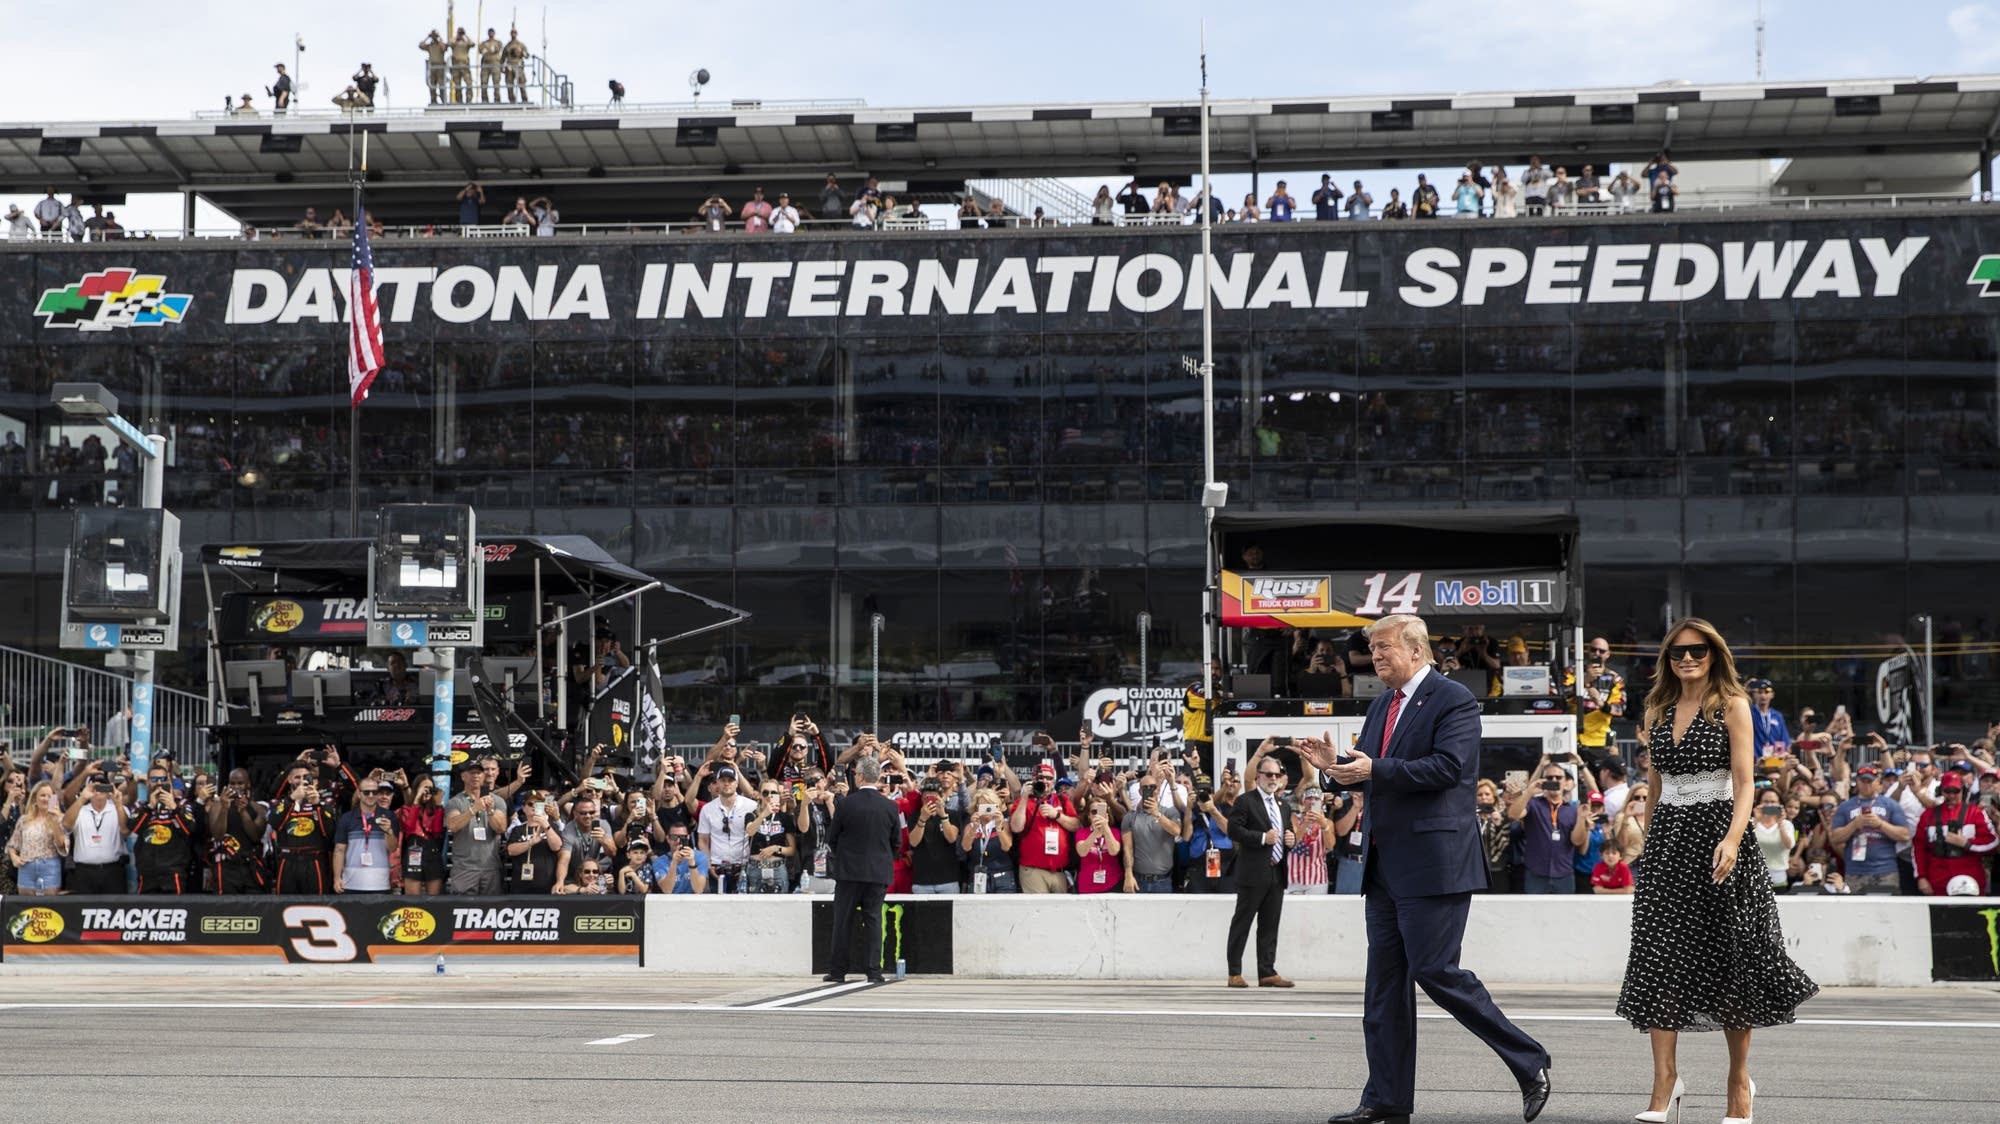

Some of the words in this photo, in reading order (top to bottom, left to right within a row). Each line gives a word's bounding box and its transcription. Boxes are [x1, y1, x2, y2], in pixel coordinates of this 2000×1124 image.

[225, 264, 610, 324] DAYTONA
[636, 250, 1369, 320] INTERNATIONAL
[1399, 236, 1930, 308] SPEEDWAY
[218, 558, 262, 567] CHEVROLET
[1355, 572, 1422, 615] 14
[1435, 579, 1518, 606] Mobil
[1258, 599, 1282, 608] TRUCK
[1283, 599, 1314, 608] CENTERS
[1130, 716, 1173, 733] LANE
[31, 909, 52, 920] Bass
[81, 908, 188, 930] TRACKER
[402, 909, 424, 920] Bass
[453, 907, 560, 929] TRACKER
[31, 918, 47, 929] Pro
[402, 918, 419, 929] Pro
[31, 926, 57, 938] Shops
[122, 930, 146, 942] OFF
[149, 930, 186, 942] ROAD
[283, 905, 358, 961] 3
[401, 927, 430, 938] Shops
[494, 930, 519, 941] OFF
[521, 930, 559, 941] ROAD
